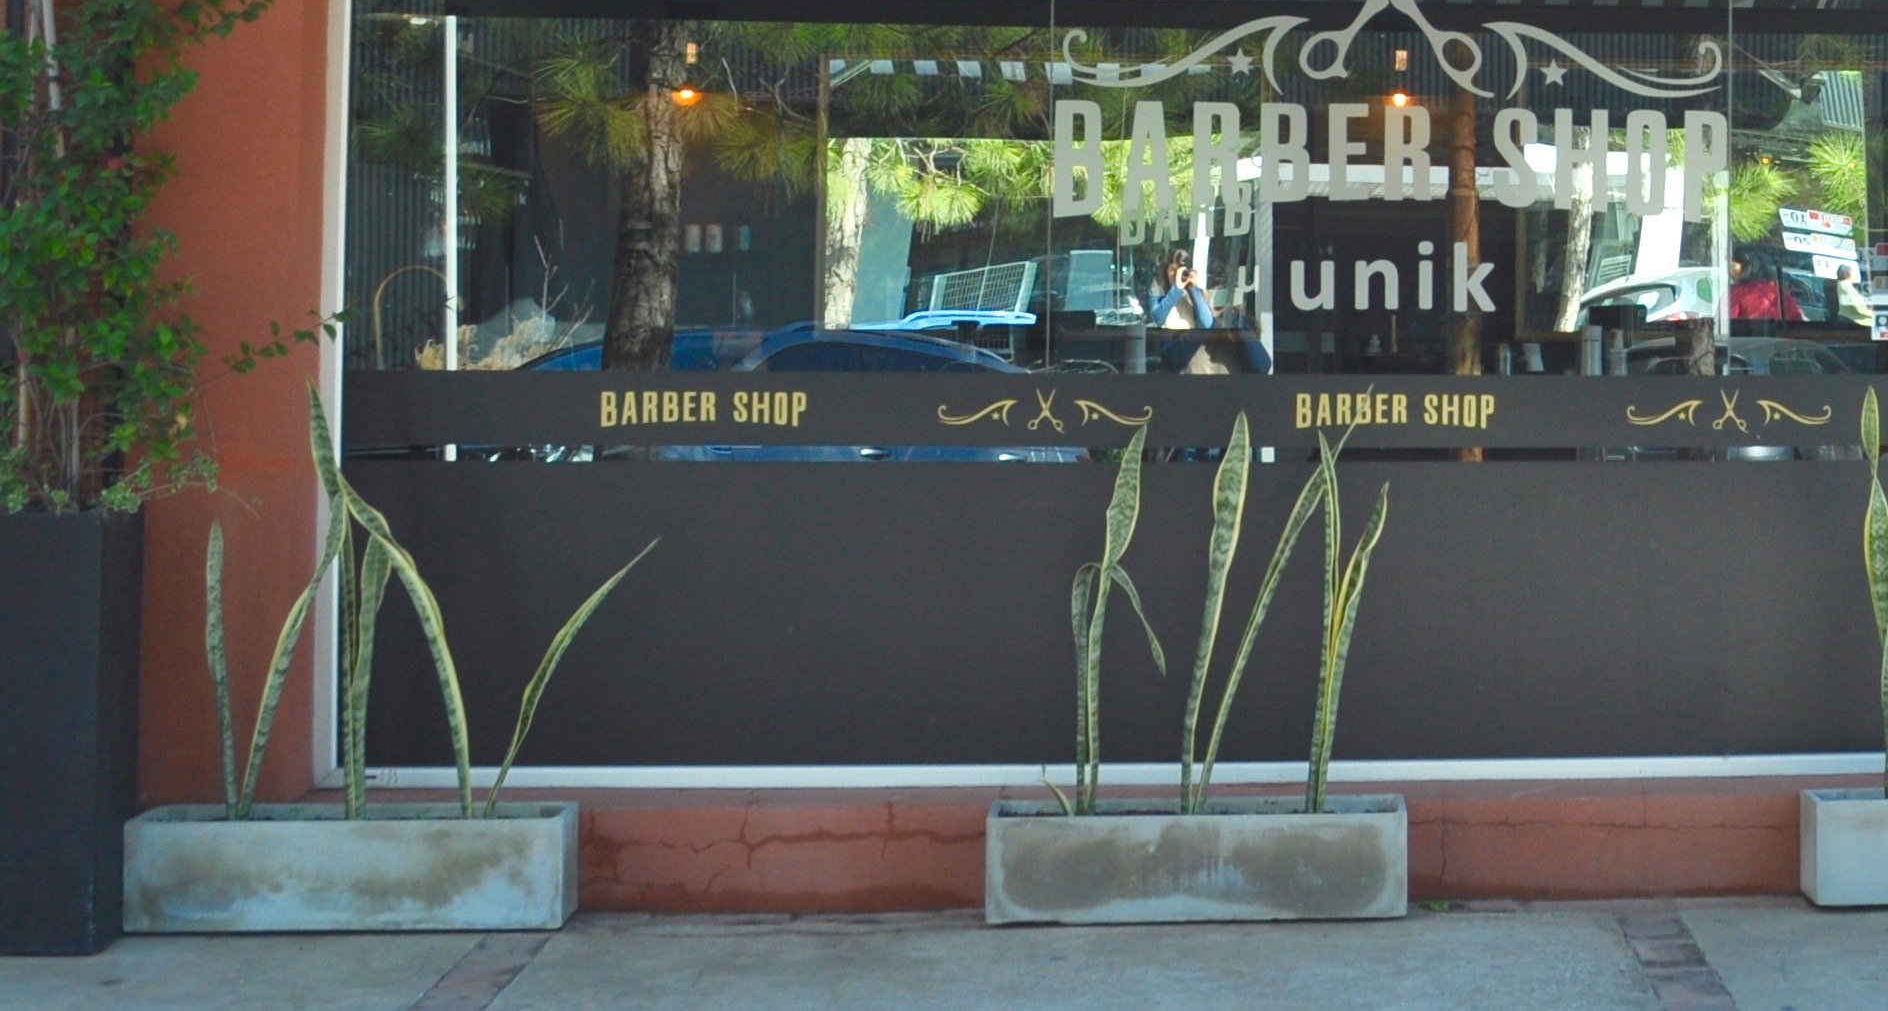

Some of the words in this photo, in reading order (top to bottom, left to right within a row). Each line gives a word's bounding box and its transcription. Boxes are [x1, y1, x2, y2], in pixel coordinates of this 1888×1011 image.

[1052, 99, 1433, 219] BARBER
[1491, 105, 1729, 224] SHOP
[1289, 240, 1497, 314] unik
[600, 391, 717, 428] BARBER
[732, 391, 808, 428] SHOP
[1295, 393, 1408, 429] BARBER
[1422, 393, 1496, 430] SHOP
